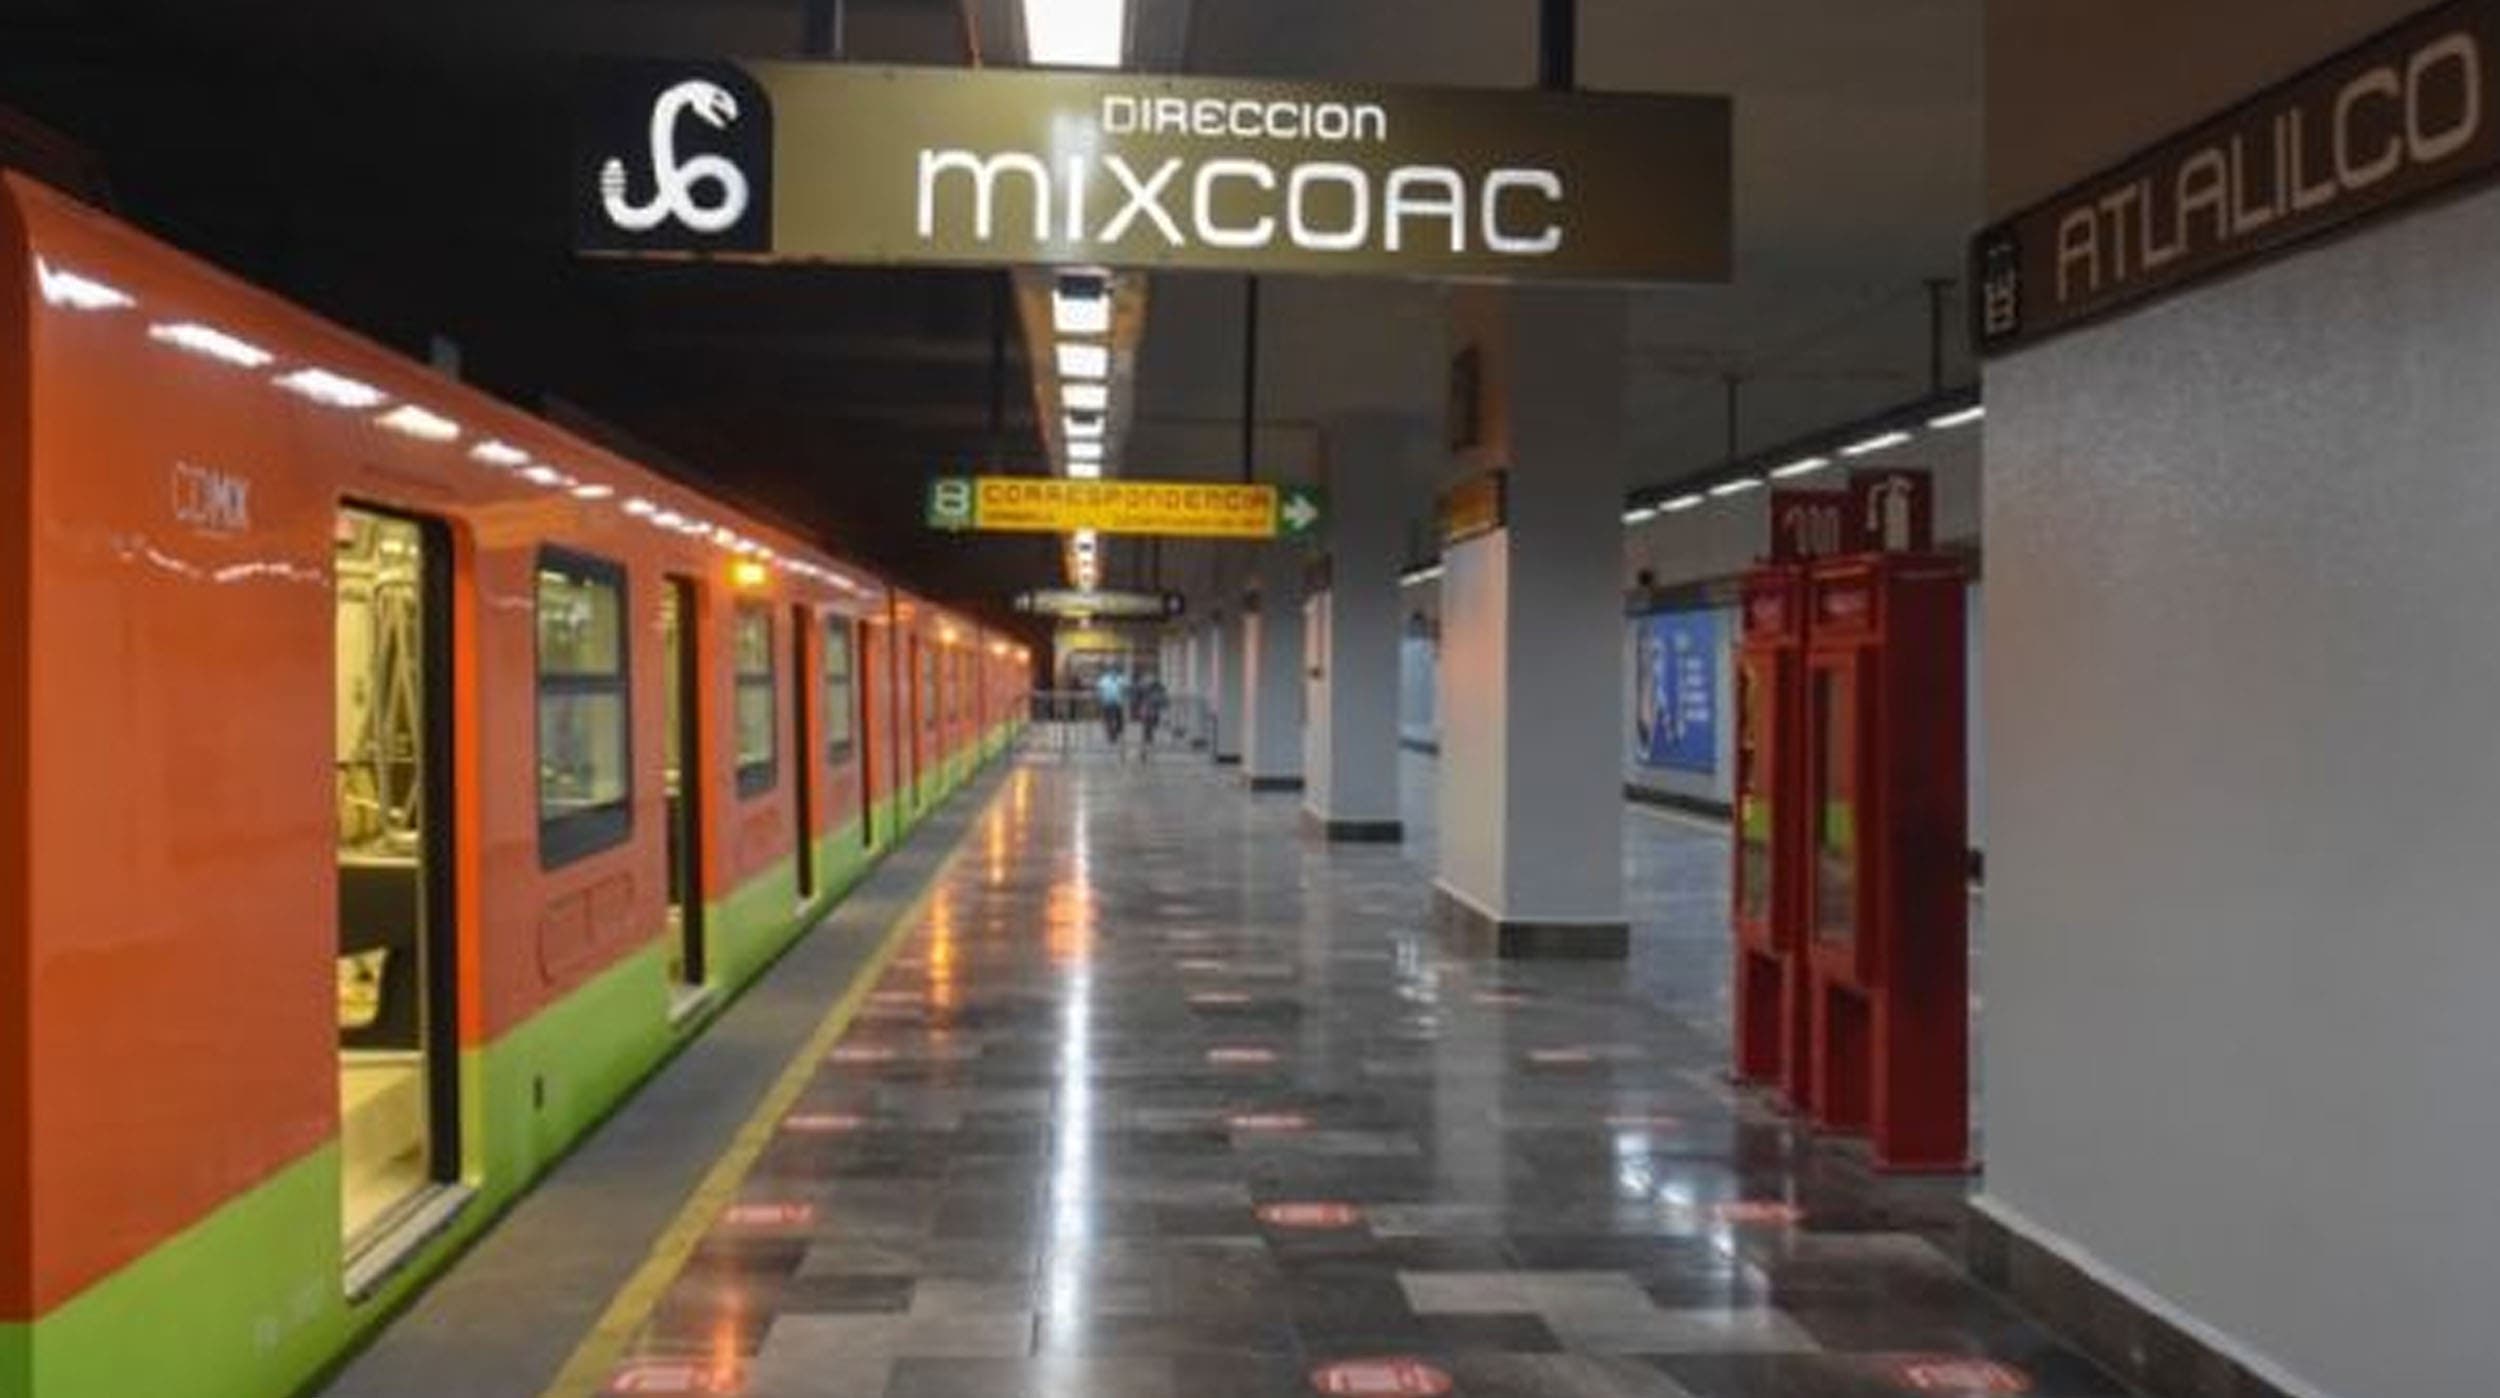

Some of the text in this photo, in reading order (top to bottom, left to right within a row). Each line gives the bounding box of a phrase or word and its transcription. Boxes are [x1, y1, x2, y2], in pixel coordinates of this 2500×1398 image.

[1102, 94, 1387, 142] DIRECCION
[2057, 32, 2481, 304] ATLALILCO
[916, 147, 1564, 255] MIXCOAC
